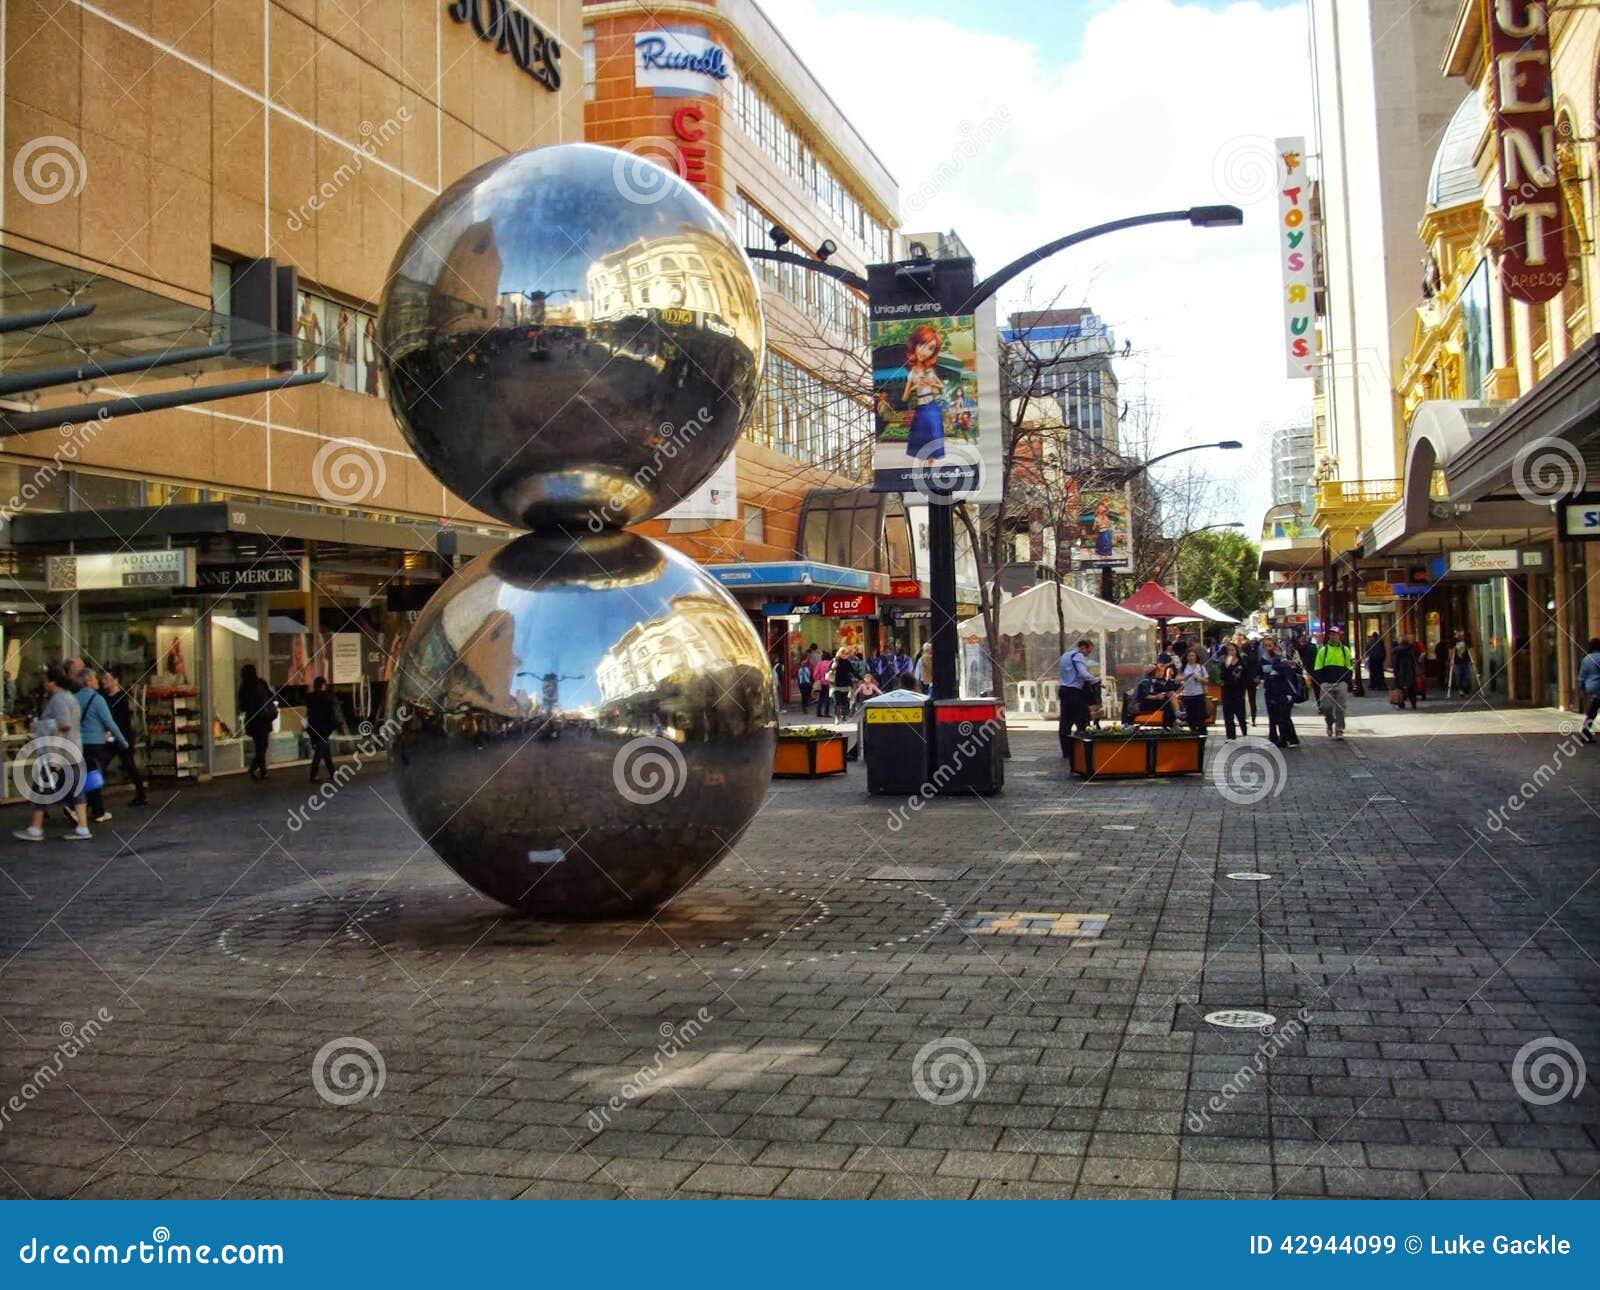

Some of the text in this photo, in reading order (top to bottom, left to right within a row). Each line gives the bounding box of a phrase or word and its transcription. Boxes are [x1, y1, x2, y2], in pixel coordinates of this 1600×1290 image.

[635, 36, 729, 80] Rundle
[672, 107, 707, 196] CE
[1282, 186, 1305, 272] TOYS
[1511, 272, 1563, 288] ARCADE
[874, 303, 912, 314] Uniquely
[1290, 316, 1310, 358] US
[121, 554, 180, 565] ADELAIDE
[1457, 552, 1487, 563] peter
[1467, 559, 1508, 568] shearer
[235, 568, 293, 584] MERCER
[832, 601, 859, 609] CIBO
